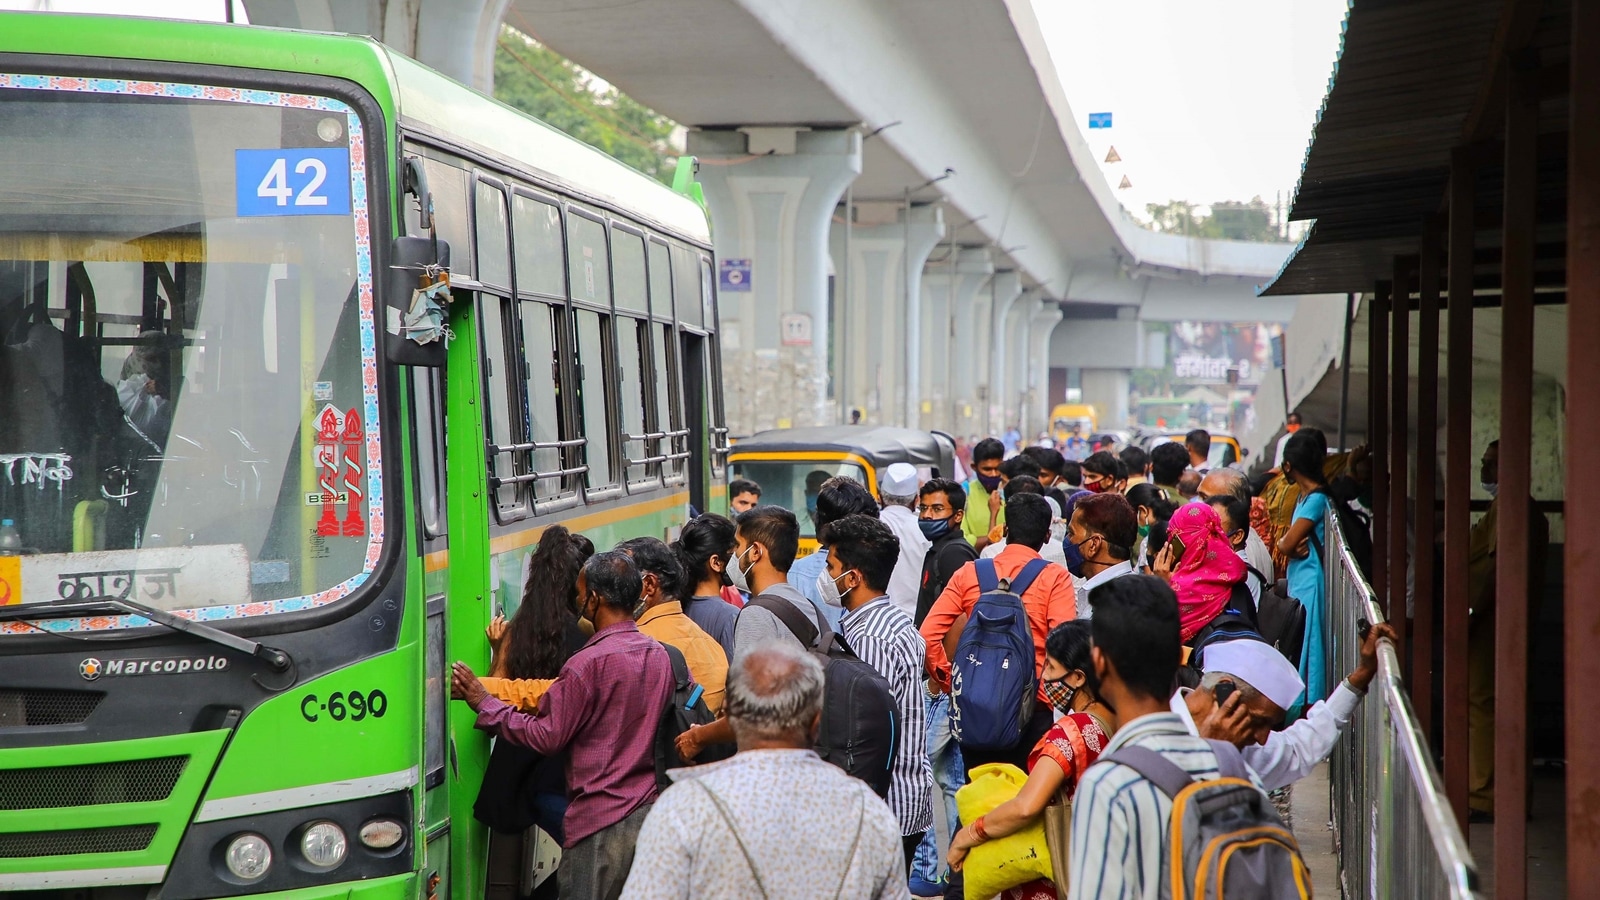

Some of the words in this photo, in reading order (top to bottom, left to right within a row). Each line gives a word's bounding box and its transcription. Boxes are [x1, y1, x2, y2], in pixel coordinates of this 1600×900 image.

[257, 158, 328, 206] 42
[105, 655, 228, 675] Marcopolo
[301, 689, 388, 722] C-690
